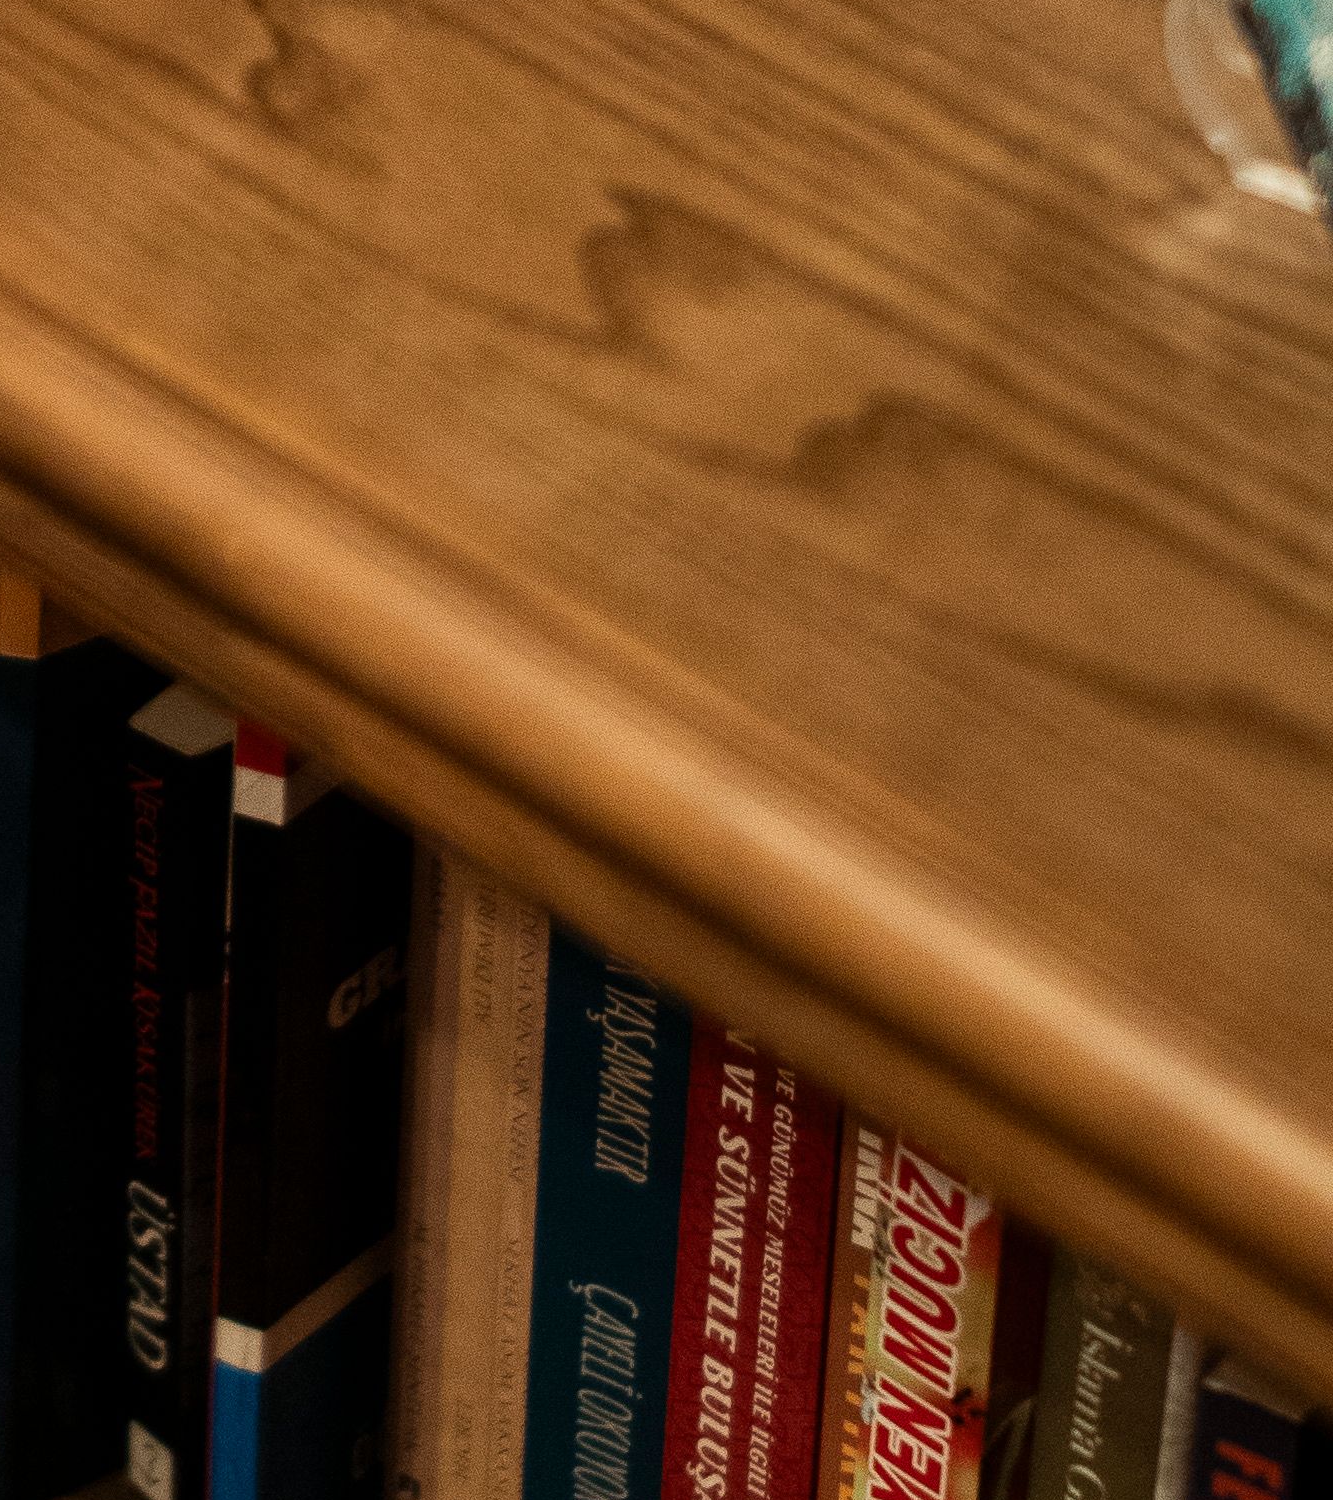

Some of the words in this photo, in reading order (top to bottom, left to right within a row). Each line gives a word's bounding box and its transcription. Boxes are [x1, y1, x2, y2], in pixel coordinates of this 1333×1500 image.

[585, 982, 659, 1187] YAŞAMAKTIR
[718, 1061, 757, 1124] VE
[764, 1106, 799, 1231] GÜNÜMÜZ
[125, 1177, 178, 1373] ÜSTAD
[703, 1125, 759, 1355] SÜNNETLE
[751, 1232, 787, 1380] MESELELERİ
[568, 1278, 643, 1404] ÇAYELİ
[751, 1383, 776, 1427] İLE
